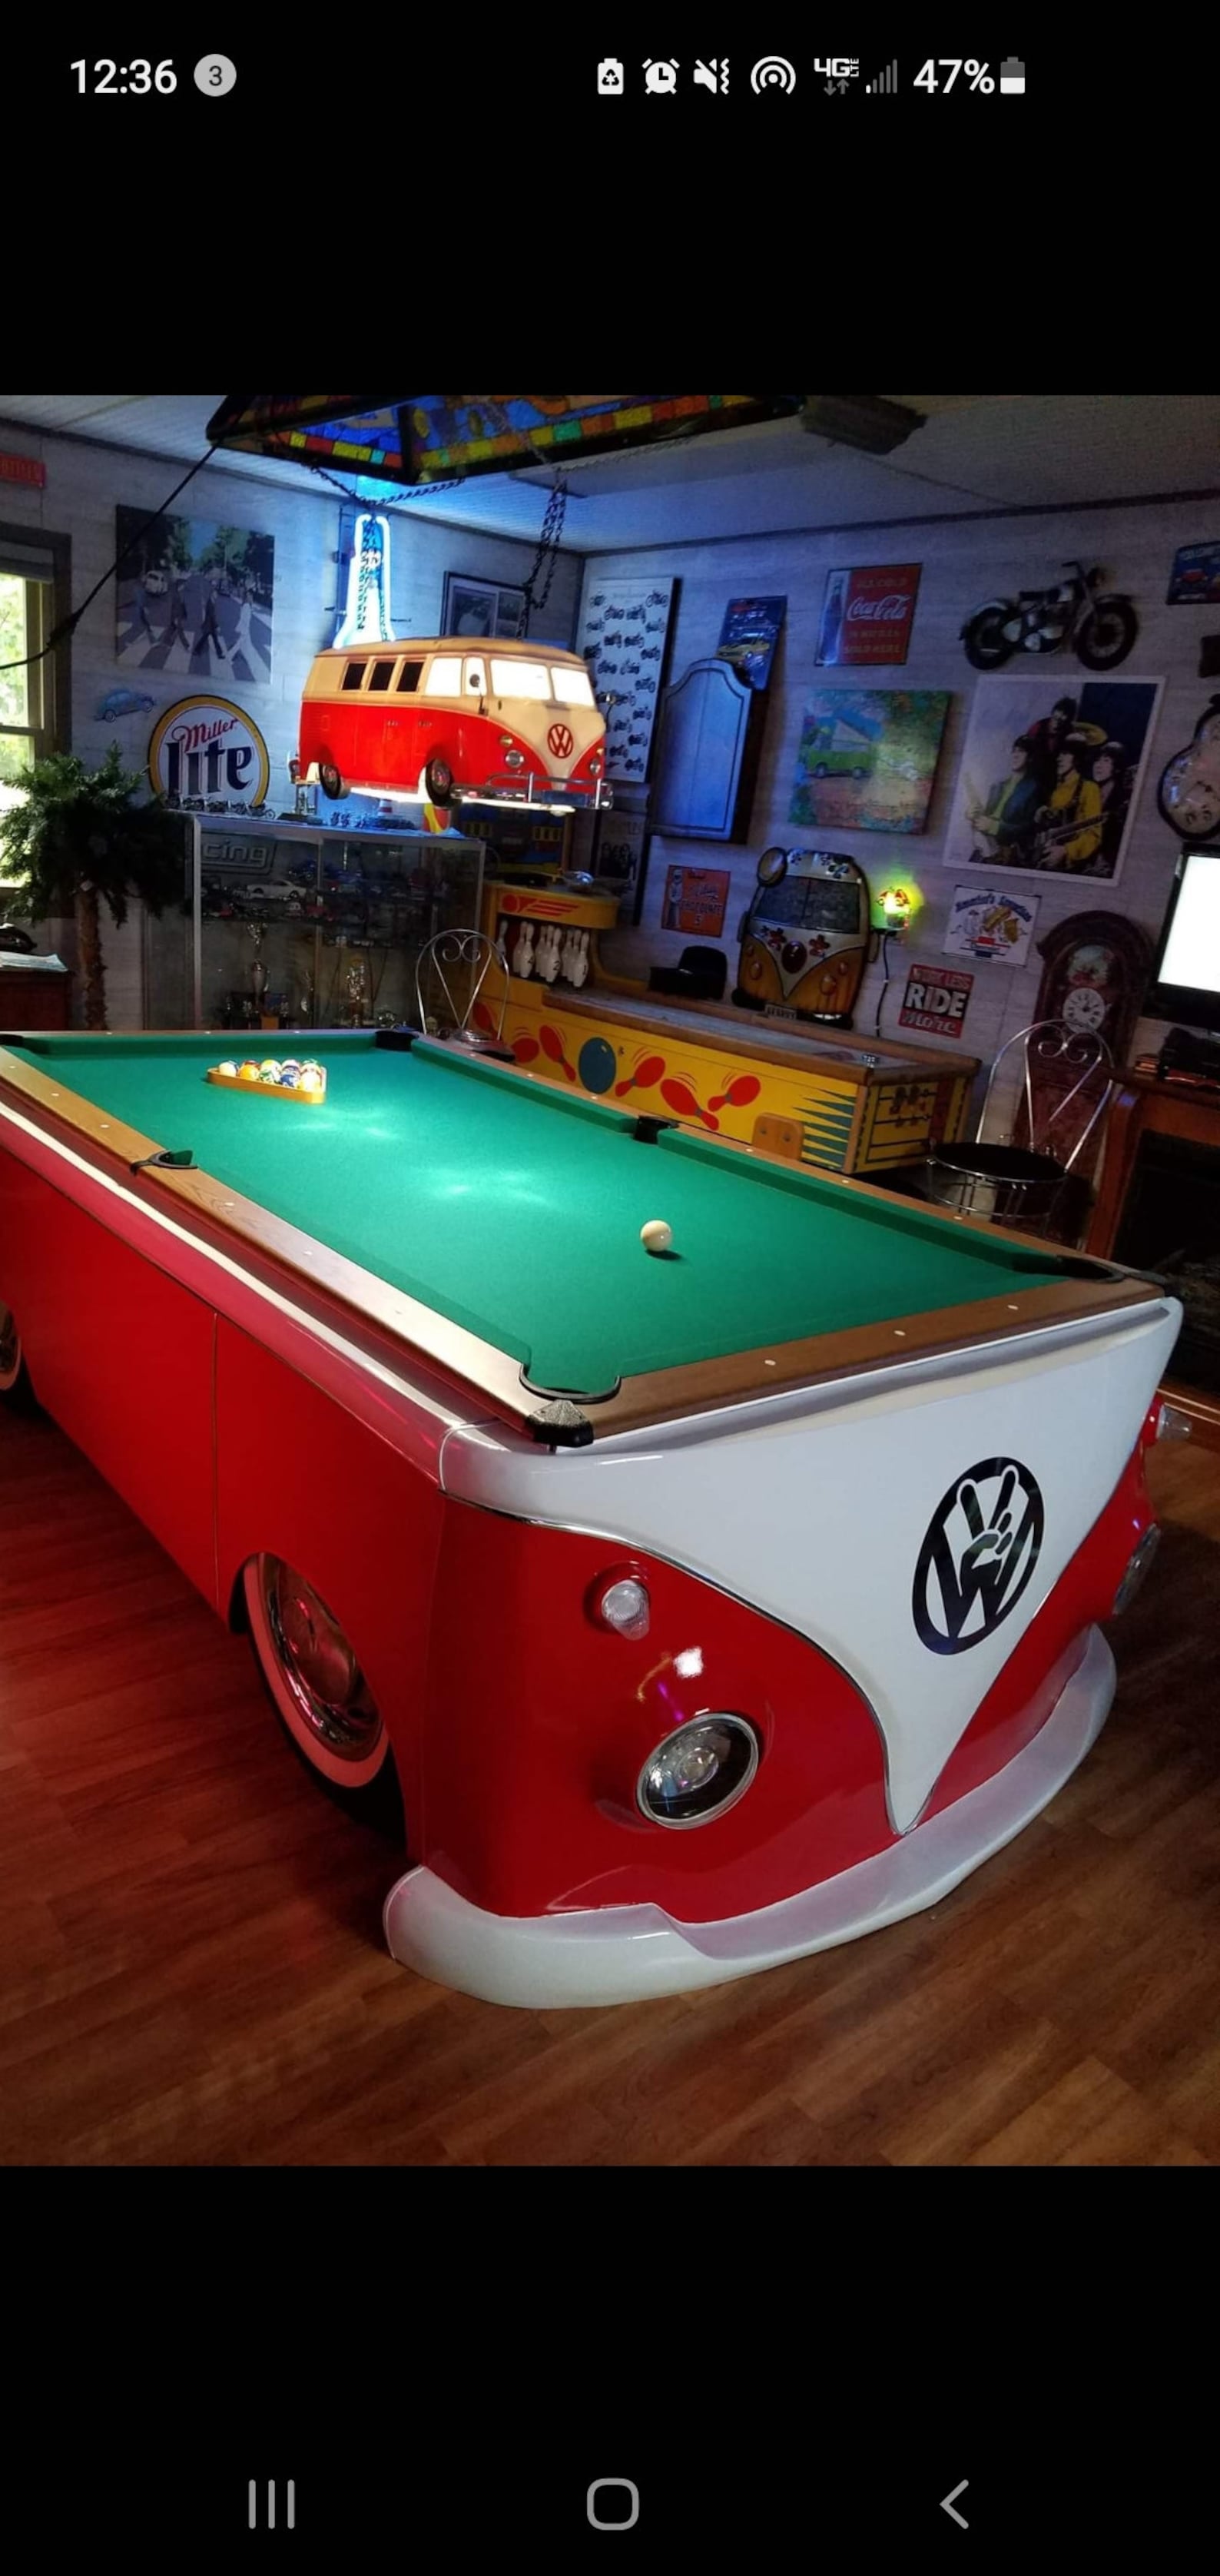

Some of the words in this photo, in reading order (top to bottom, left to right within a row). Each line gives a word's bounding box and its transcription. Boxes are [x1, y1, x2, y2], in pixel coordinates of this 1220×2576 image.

[172, 719, 240, 753] Miller
[166, 739, 253, 798] lite
[905, 982, 967, 1018] RIDE
